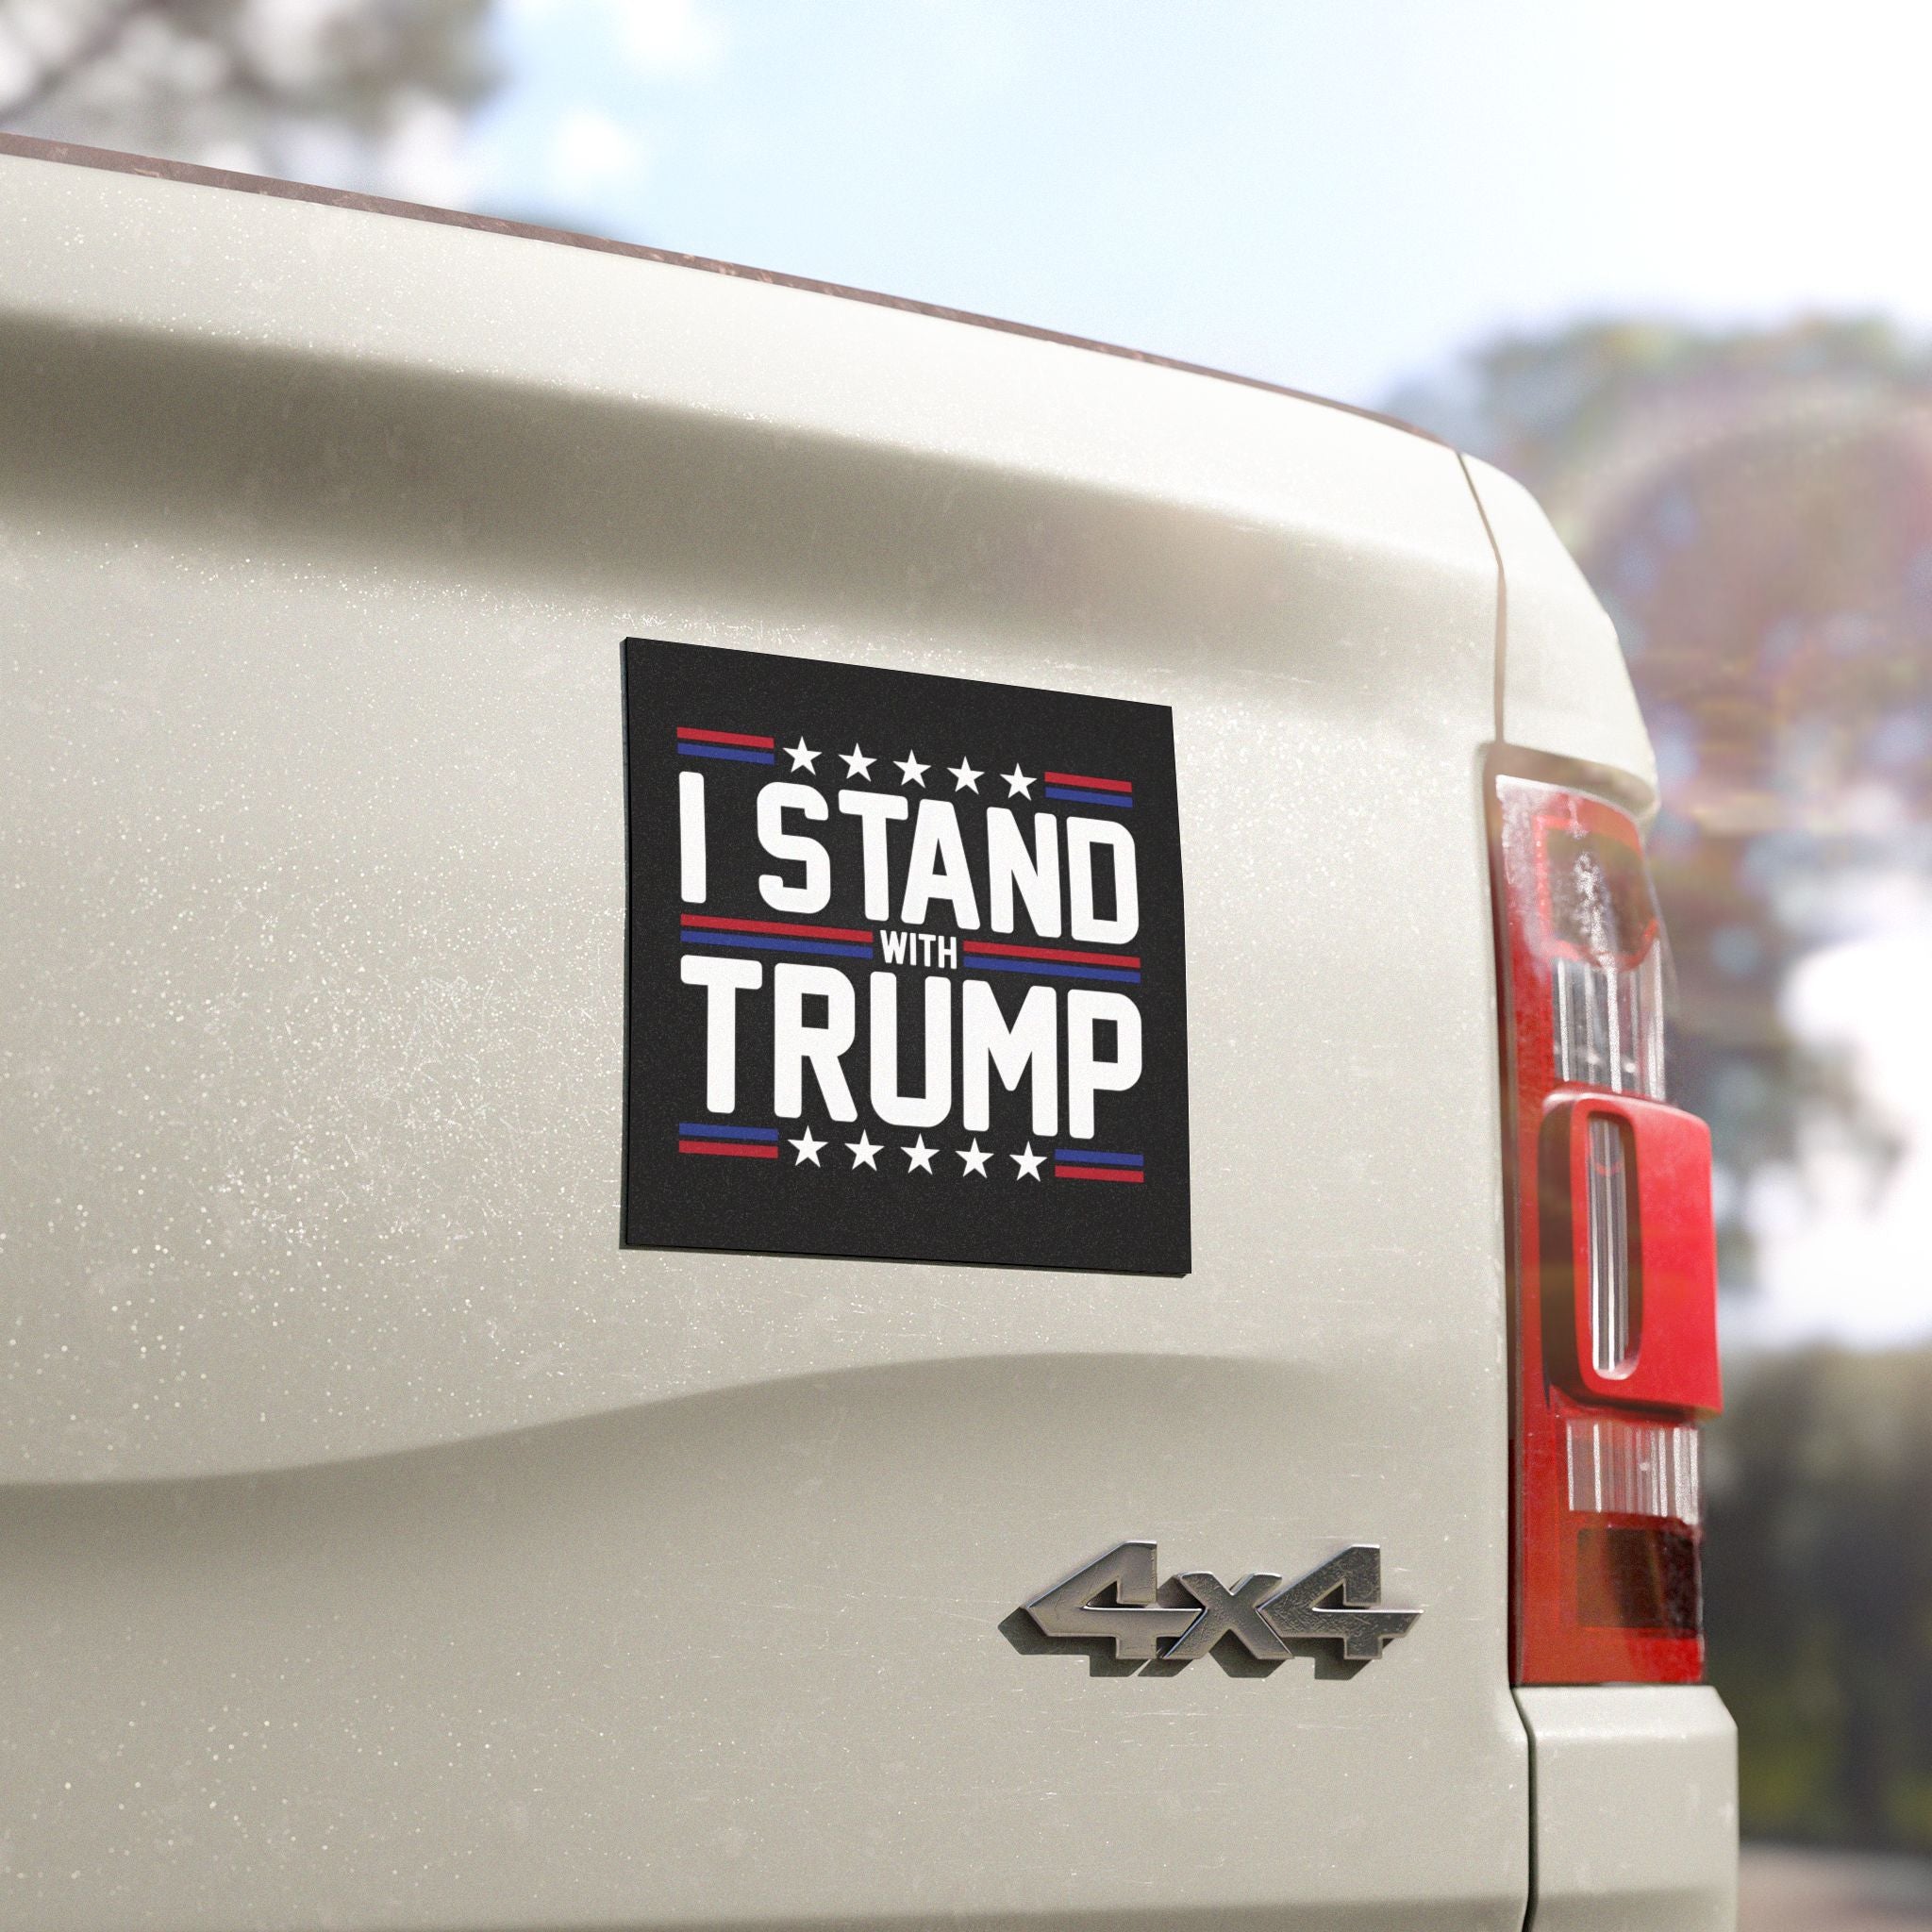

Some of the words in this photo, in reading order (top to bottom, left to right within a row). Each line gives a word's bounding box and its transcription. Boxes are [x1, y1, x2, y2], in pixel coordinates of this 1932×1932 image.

[678, 771, 707, 904] I
[756, 781, 1140, 945] STAND
[879, 929, 958, 970] WITH
[680, 954, 1142, 1140] TRUMP
[1025, 1541, 1424, 1659] 4x4
